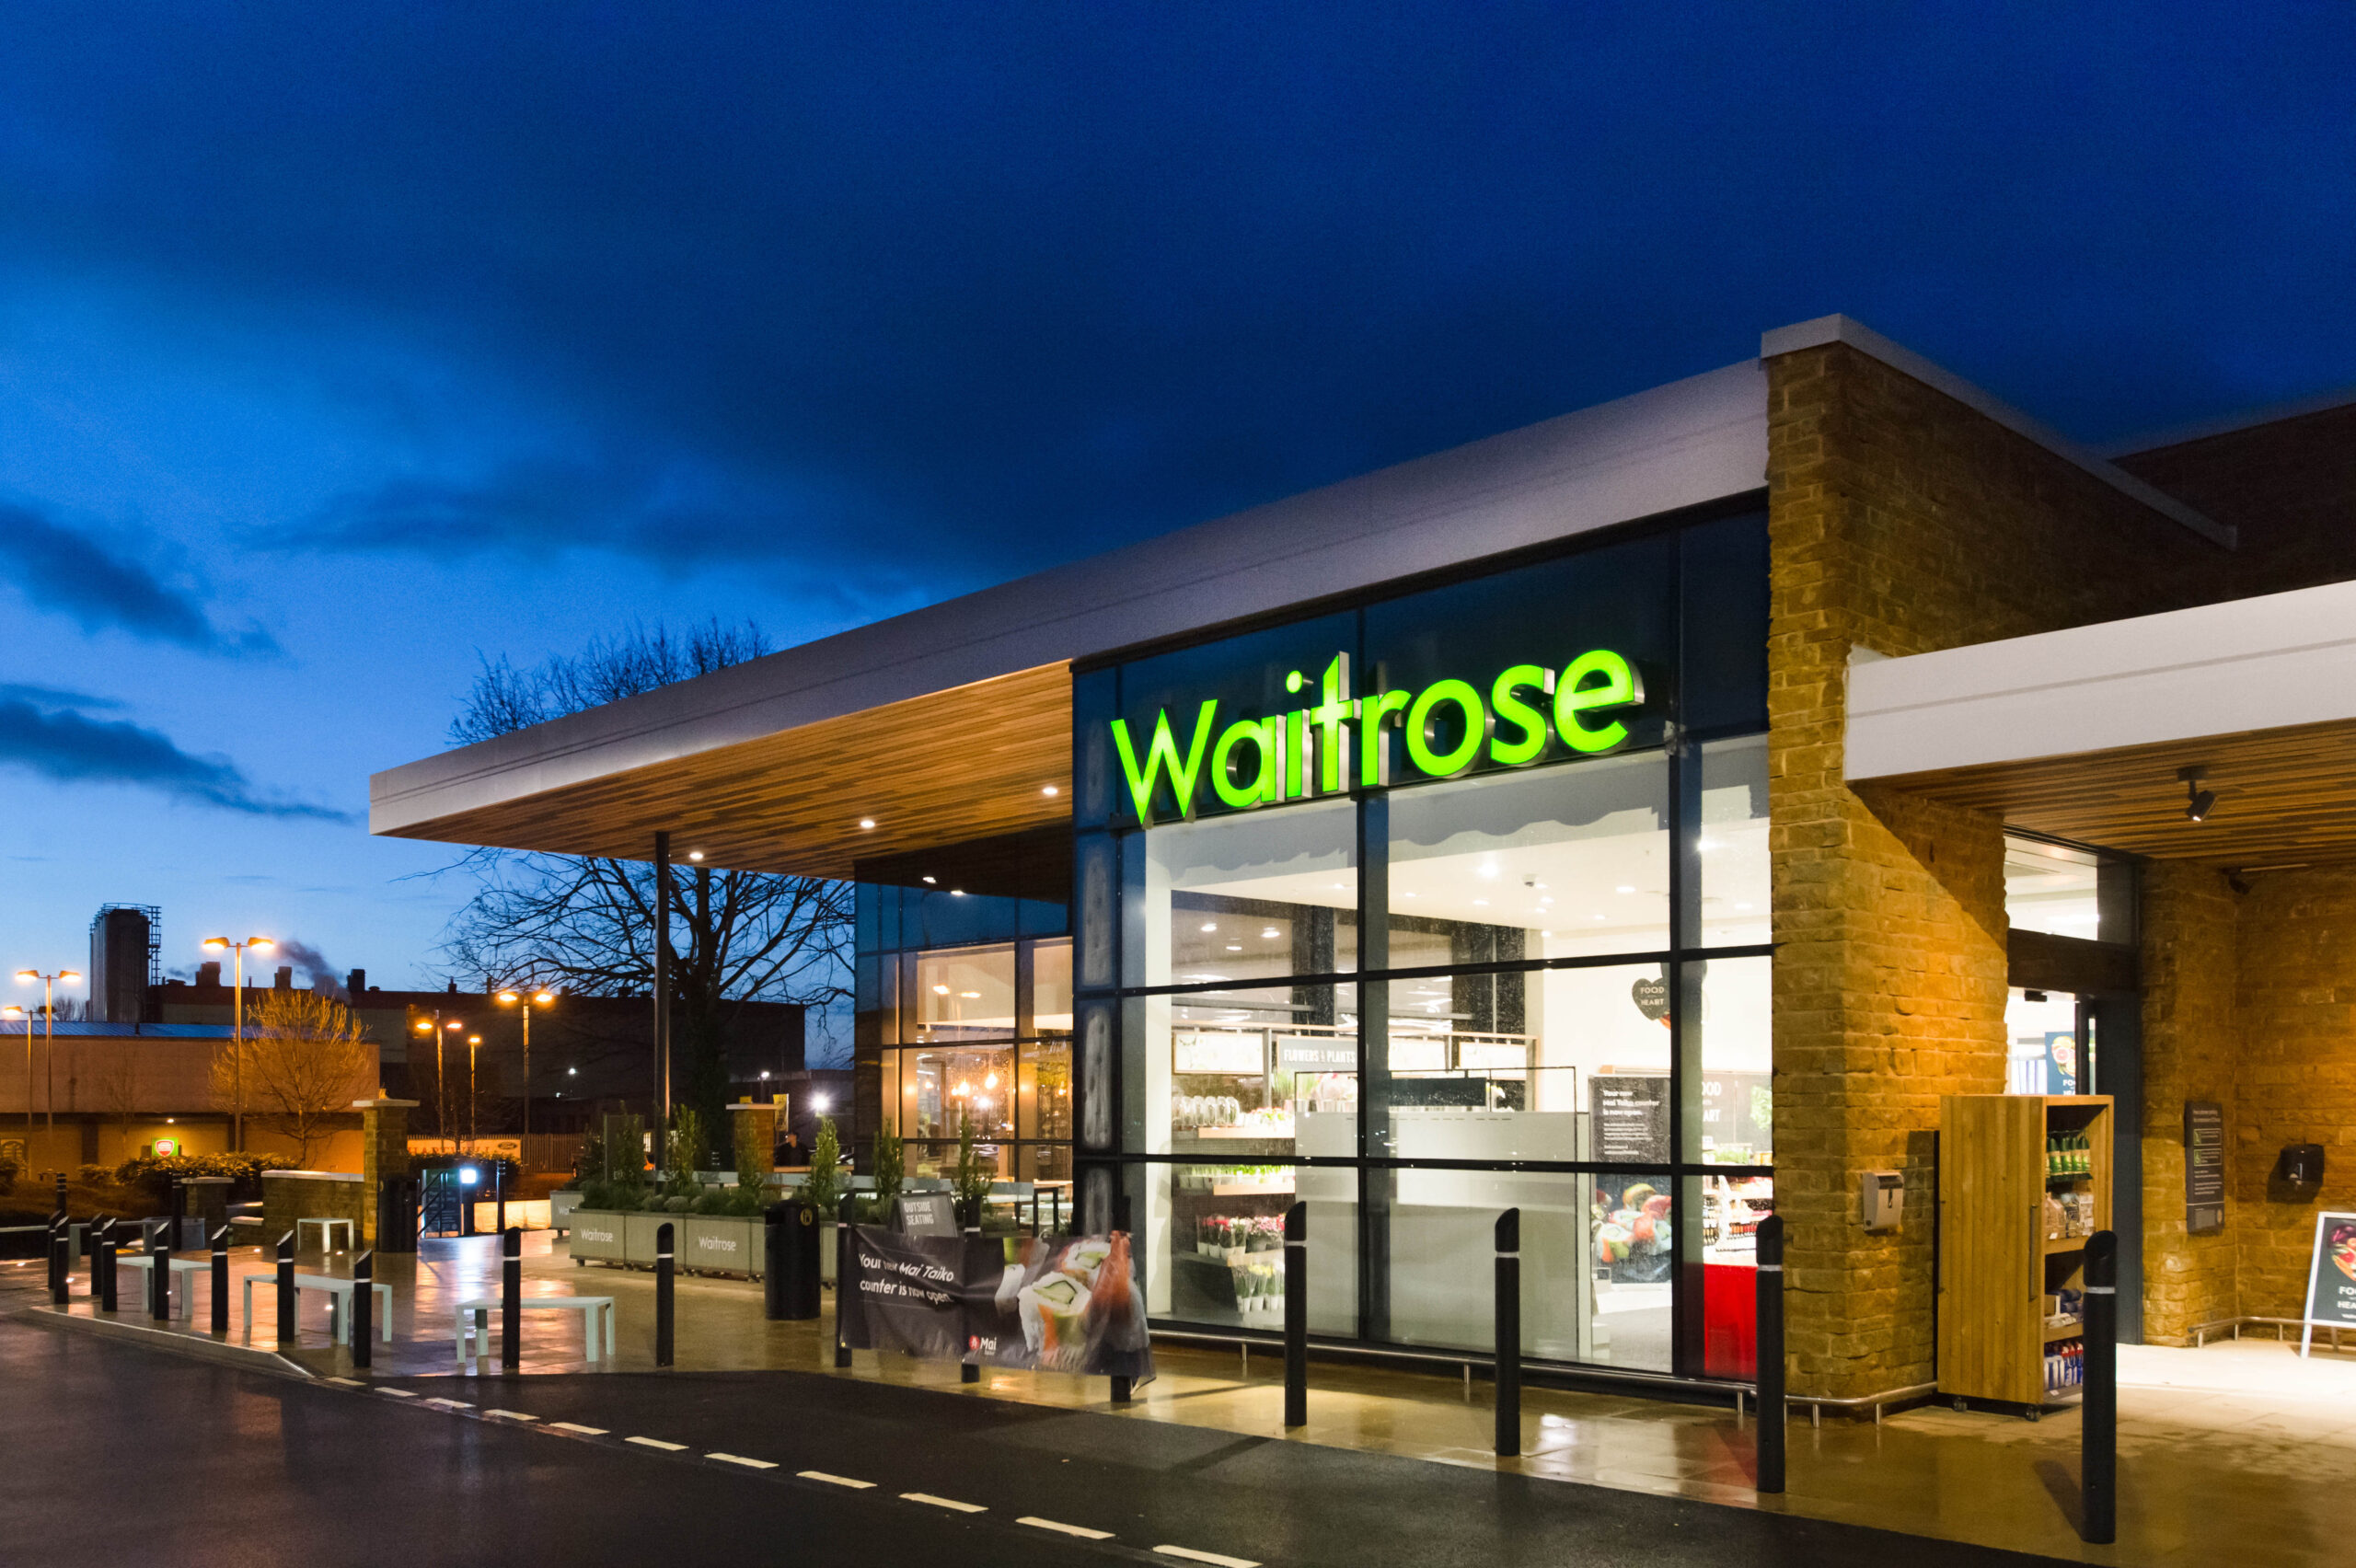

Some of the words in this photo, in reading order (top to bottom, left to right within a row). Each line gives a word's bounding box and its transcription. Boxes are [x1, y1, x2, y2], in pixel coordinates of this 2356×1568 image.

[1111, 649, 1645, 829] Waitrose
[1284, 1049, 1319, 1062] FLOWERS
[1327, 1051, 1356, 1063] PLANTS
[904, 1202, 931, 1213] OUTSIDE
[907, 1215, 934, 1225] SEATING
[581, 1228, 613, 1242] Waitrose
[699, 1236, 736, 1251] Waitrose
[859, 1253, 881, 1269] Your
[899, 1262, 923, 1276] Mai
[922, 1265, 954, 1282] Taiko
[860, 1278, 896, 1294] counter
[898, 1281, 907, 1296] is
[980, 1337, 997, 1350] Mai
